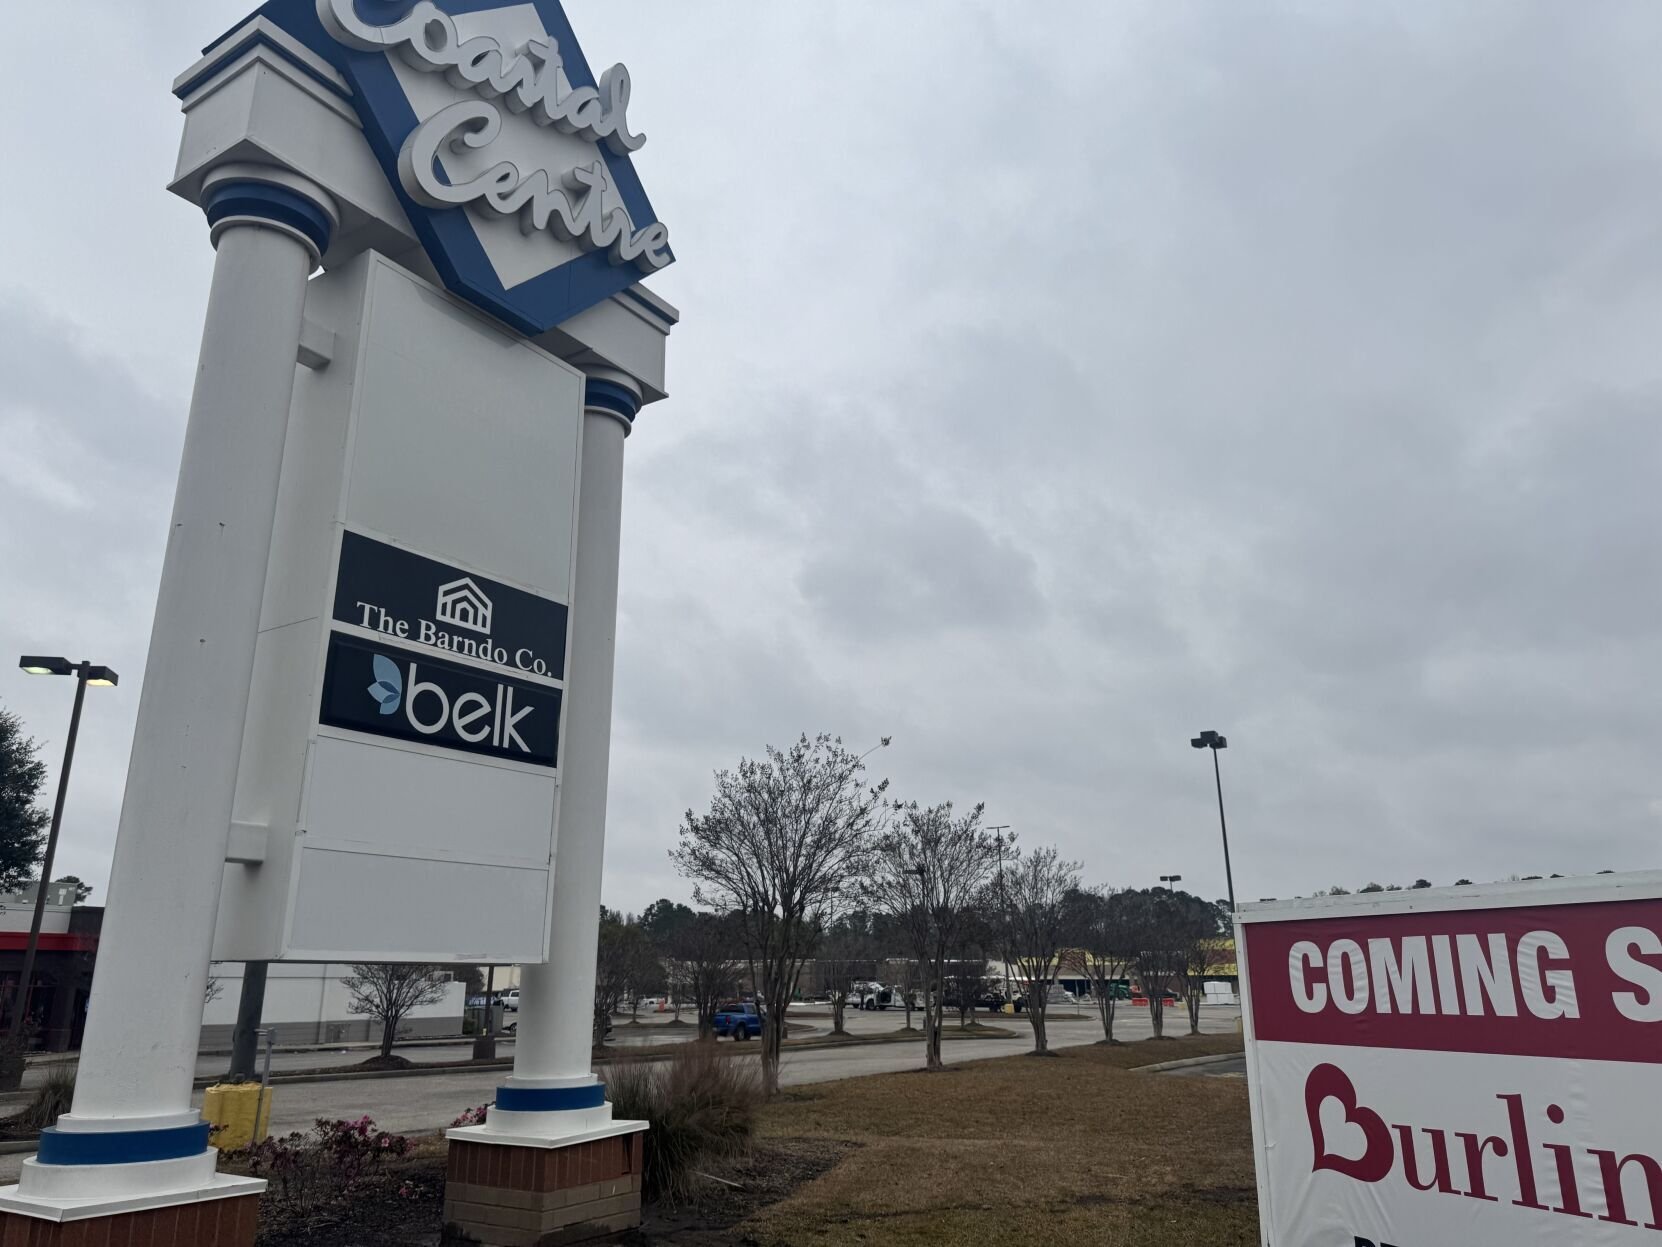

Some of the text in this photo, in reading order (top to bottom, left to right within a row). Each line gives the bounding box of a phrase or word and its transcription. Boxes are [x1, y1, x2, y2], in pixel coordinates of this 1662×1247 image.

[398, 101, 669, 270] Centre
[357, 601, 552, 677] The Barndo Co.
[406, 662, 535, 752] belk
[1288, 930, 1581, 1020] COMING
